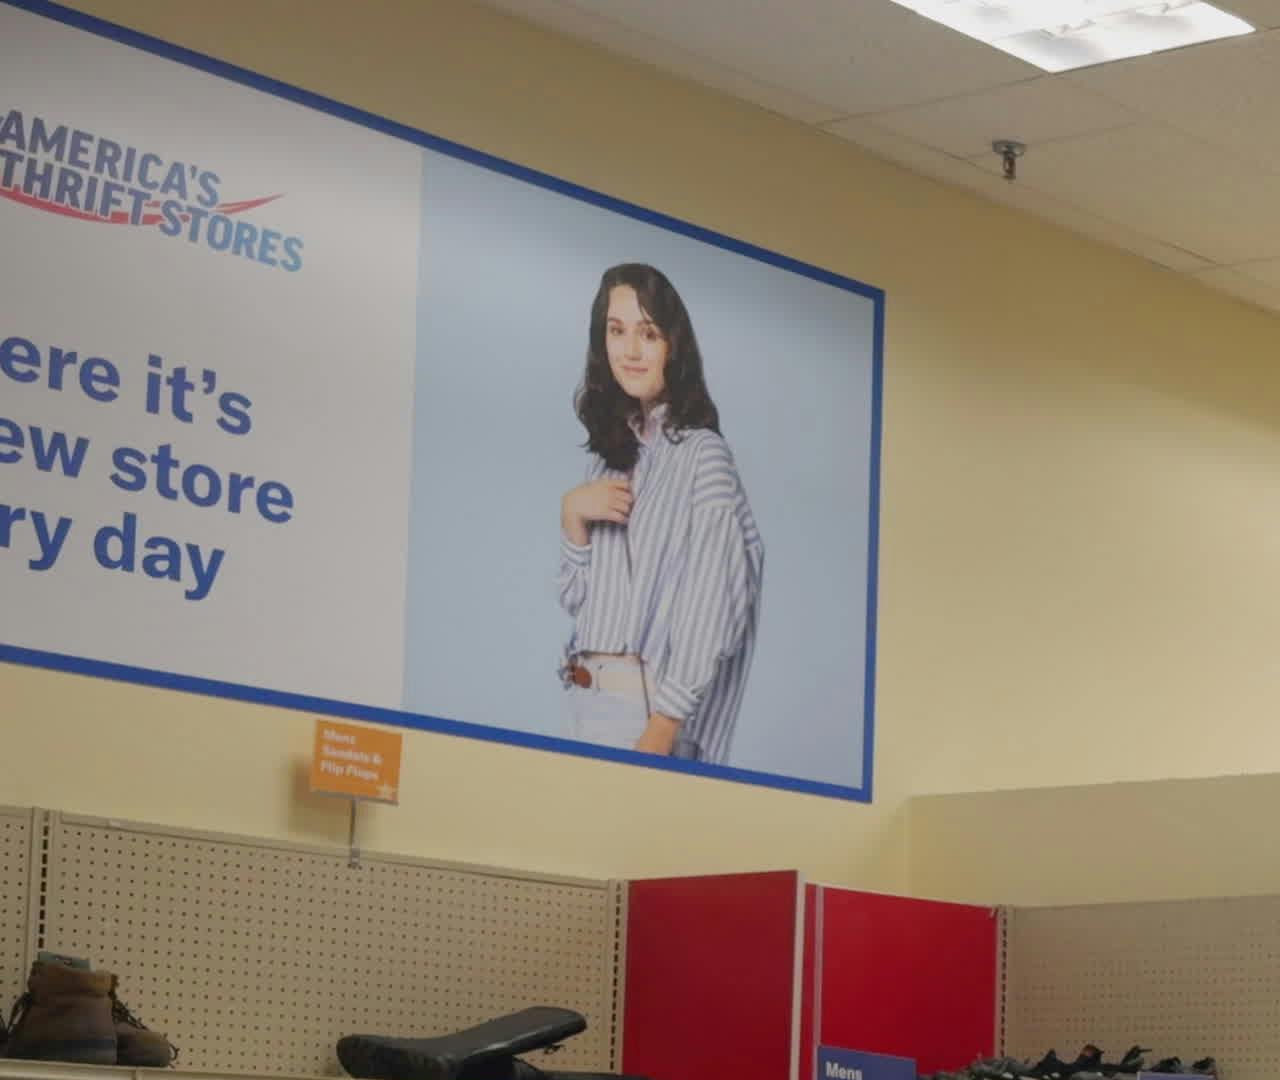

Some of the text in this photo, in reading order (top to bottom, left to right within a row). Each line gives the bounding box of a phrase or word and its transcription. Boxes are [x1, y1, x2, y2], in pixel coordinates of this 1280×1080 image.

[0, 109, 221, 209] AMERICA'S
[0, 151, 304, 273] THRIFT STORES
[109, 444, 294, 524] store
[94, 511, 225, 601] day
